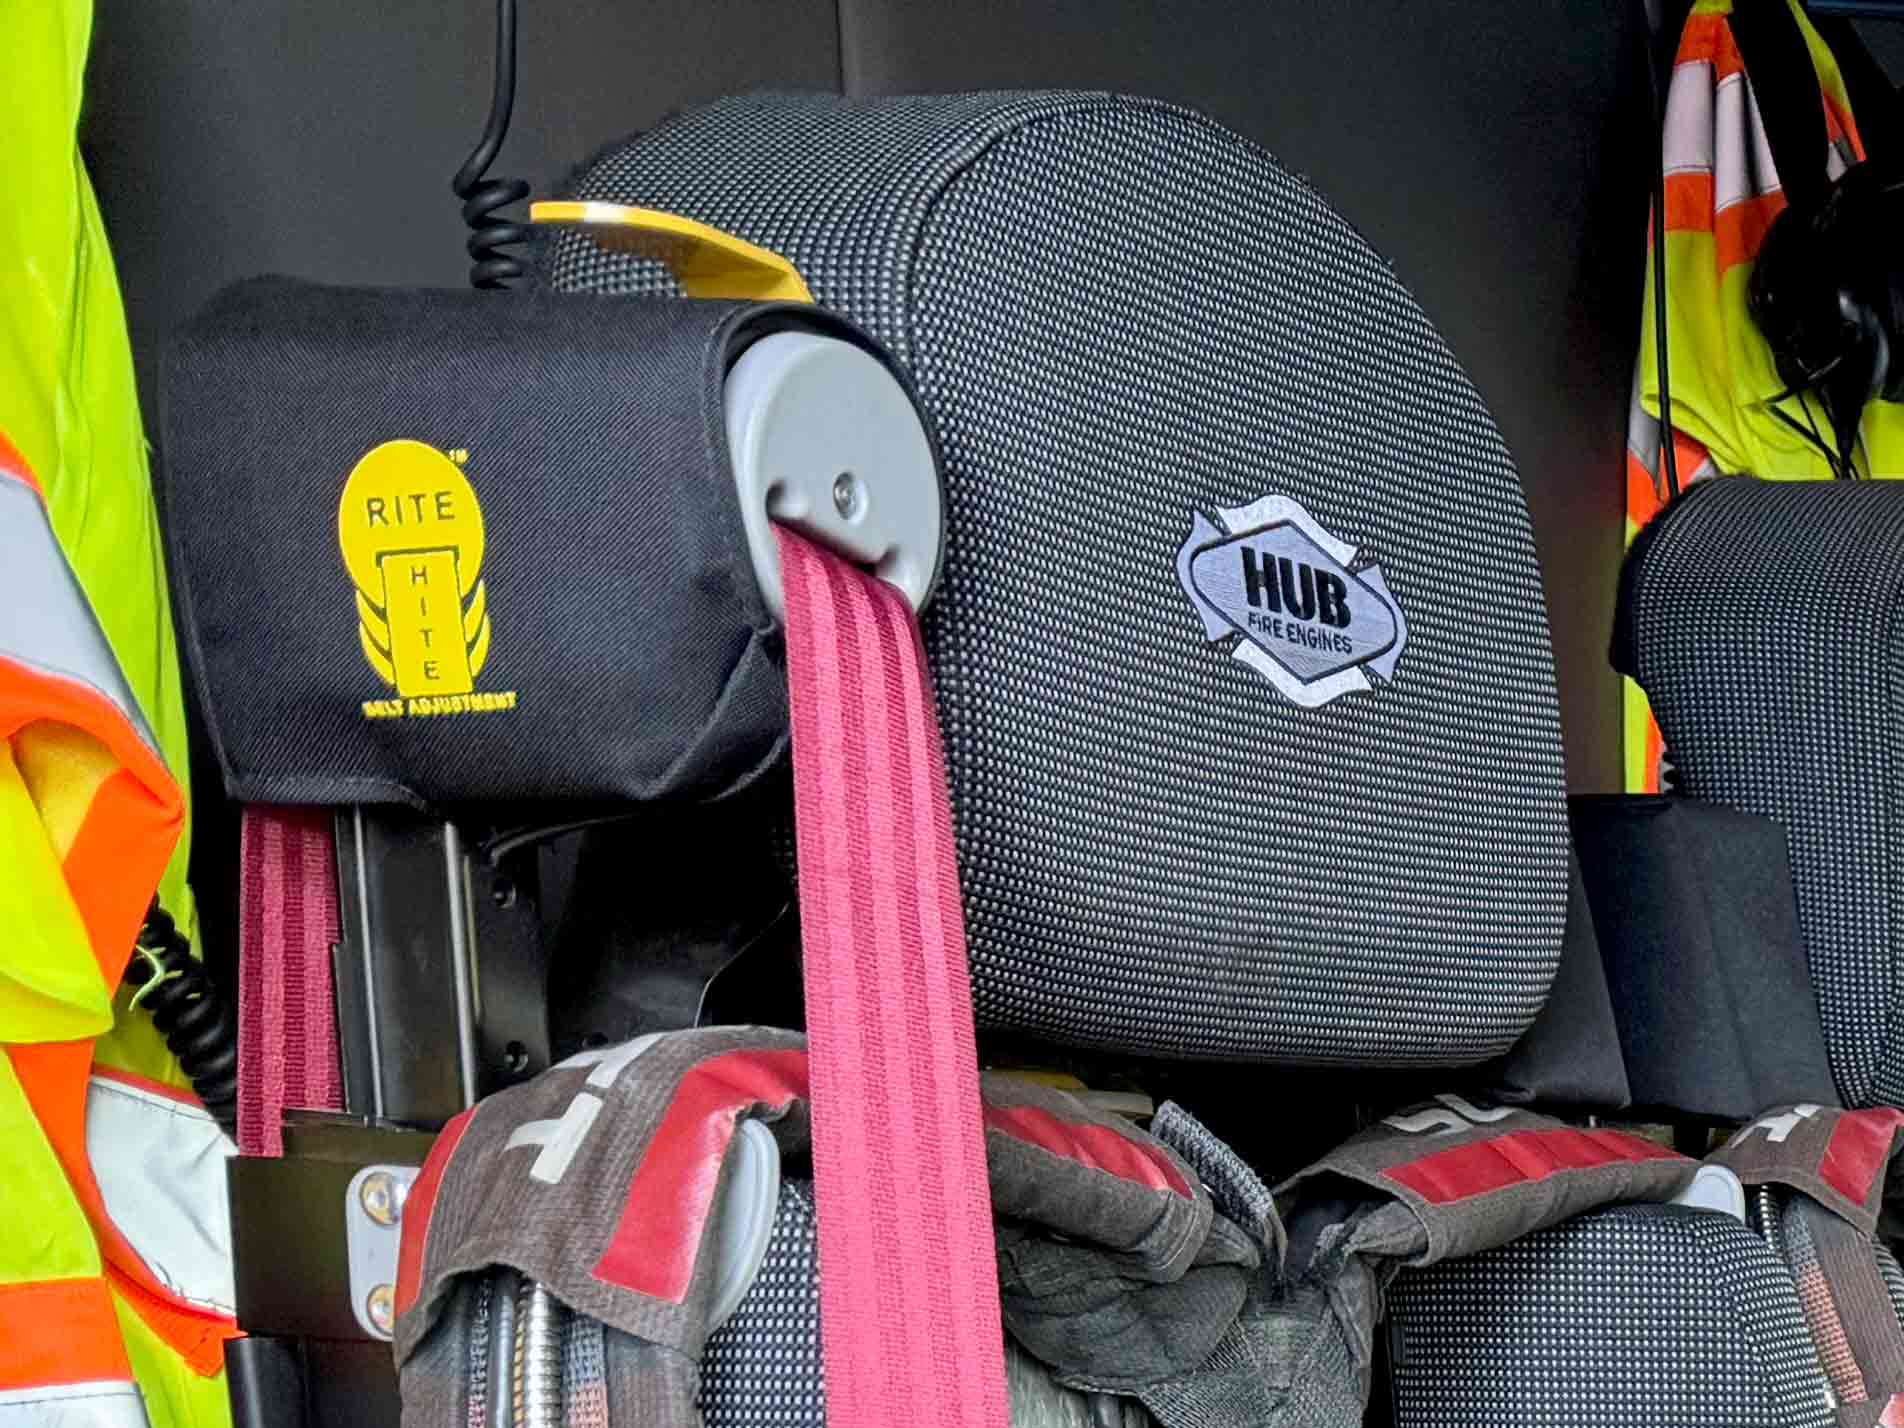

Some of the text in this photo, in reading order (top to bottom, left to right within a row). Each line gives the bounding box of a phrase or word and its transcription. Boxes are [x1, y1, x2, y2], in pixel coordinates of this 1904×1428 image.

[366, 491, 455, 528] RITE
[1240, 546, 1352, 629] HUB
[1247, 612, 1353, 655] FIRE ENGINES
